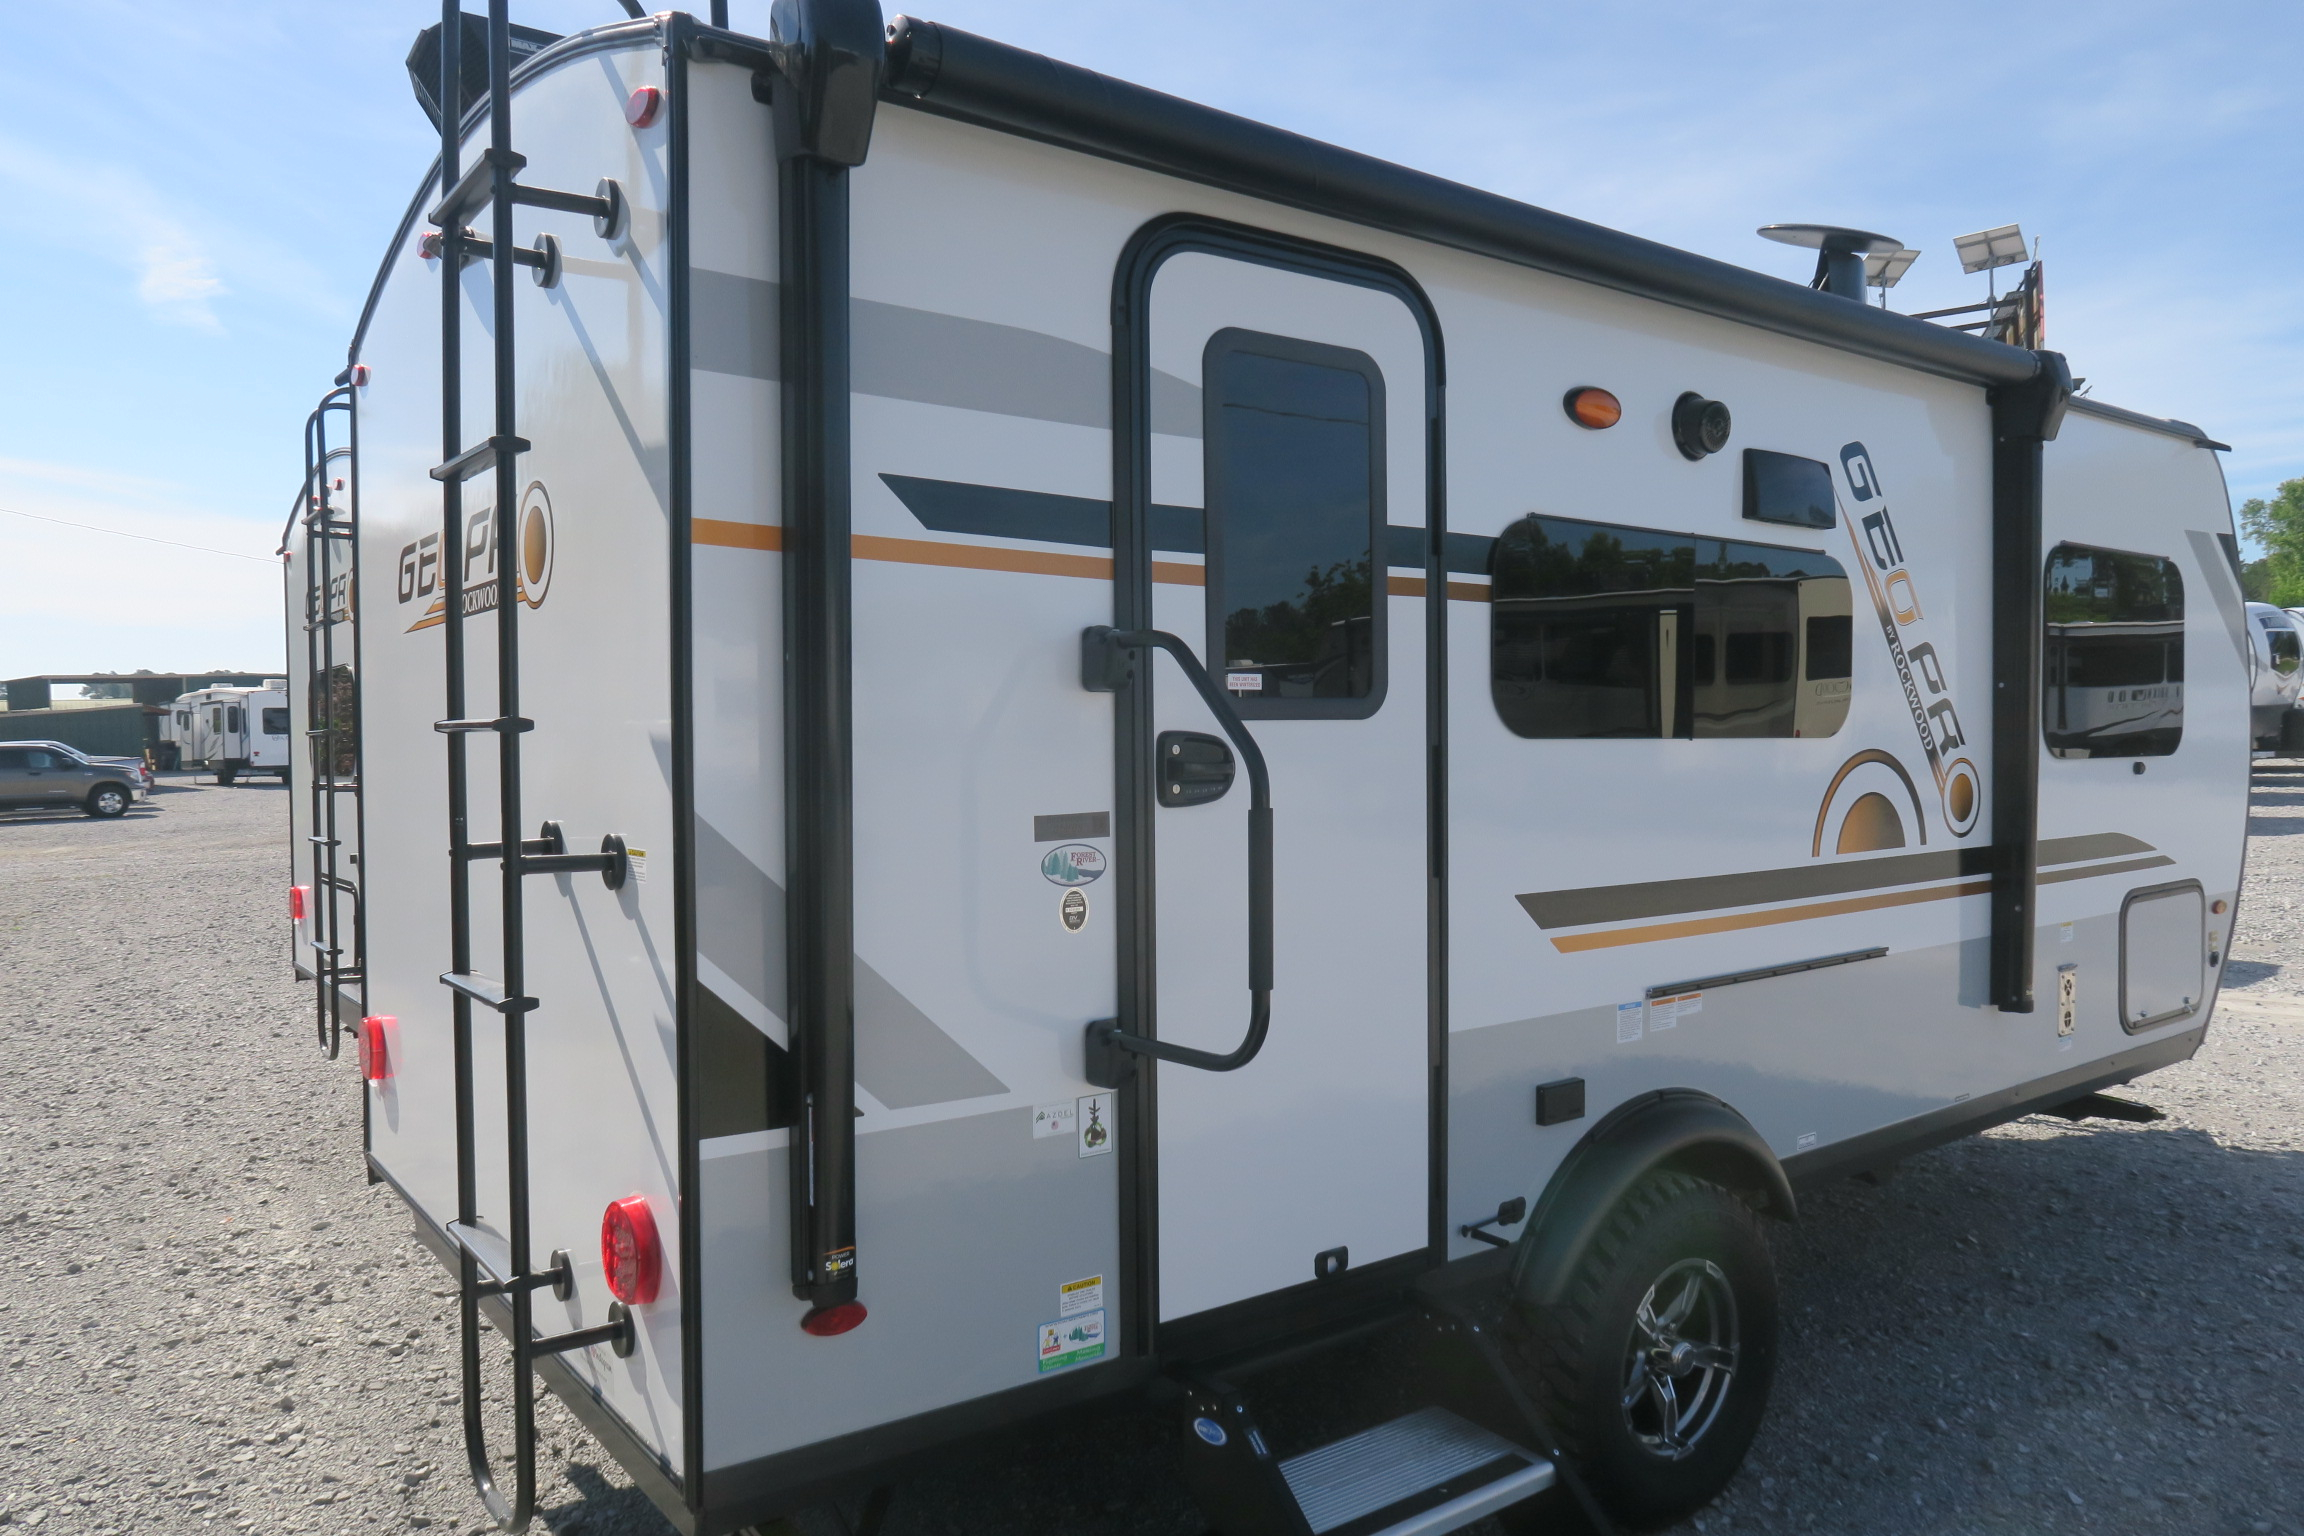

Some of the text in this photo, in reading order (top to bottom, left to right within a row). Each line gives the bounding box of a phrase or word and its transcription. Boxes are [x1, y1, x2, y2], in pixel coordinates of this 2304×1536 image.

[1839, 440, 1924, 626] GEO
[463, 584, 499, 613] OCKWOO
[1886, 625, 1934, 751] BY ROCKWOOD
[1070, 851, 1097, 862] FOREST
[1075, 857, 1097, 867] RIVER
[1046, 1108, 1074, 1120] AZDEL
[831, 1251, 850, 1260] POWER
[825, 1258, 854, 1271] Solera
[1072, 1280, 1096, 1291] CAUTION
